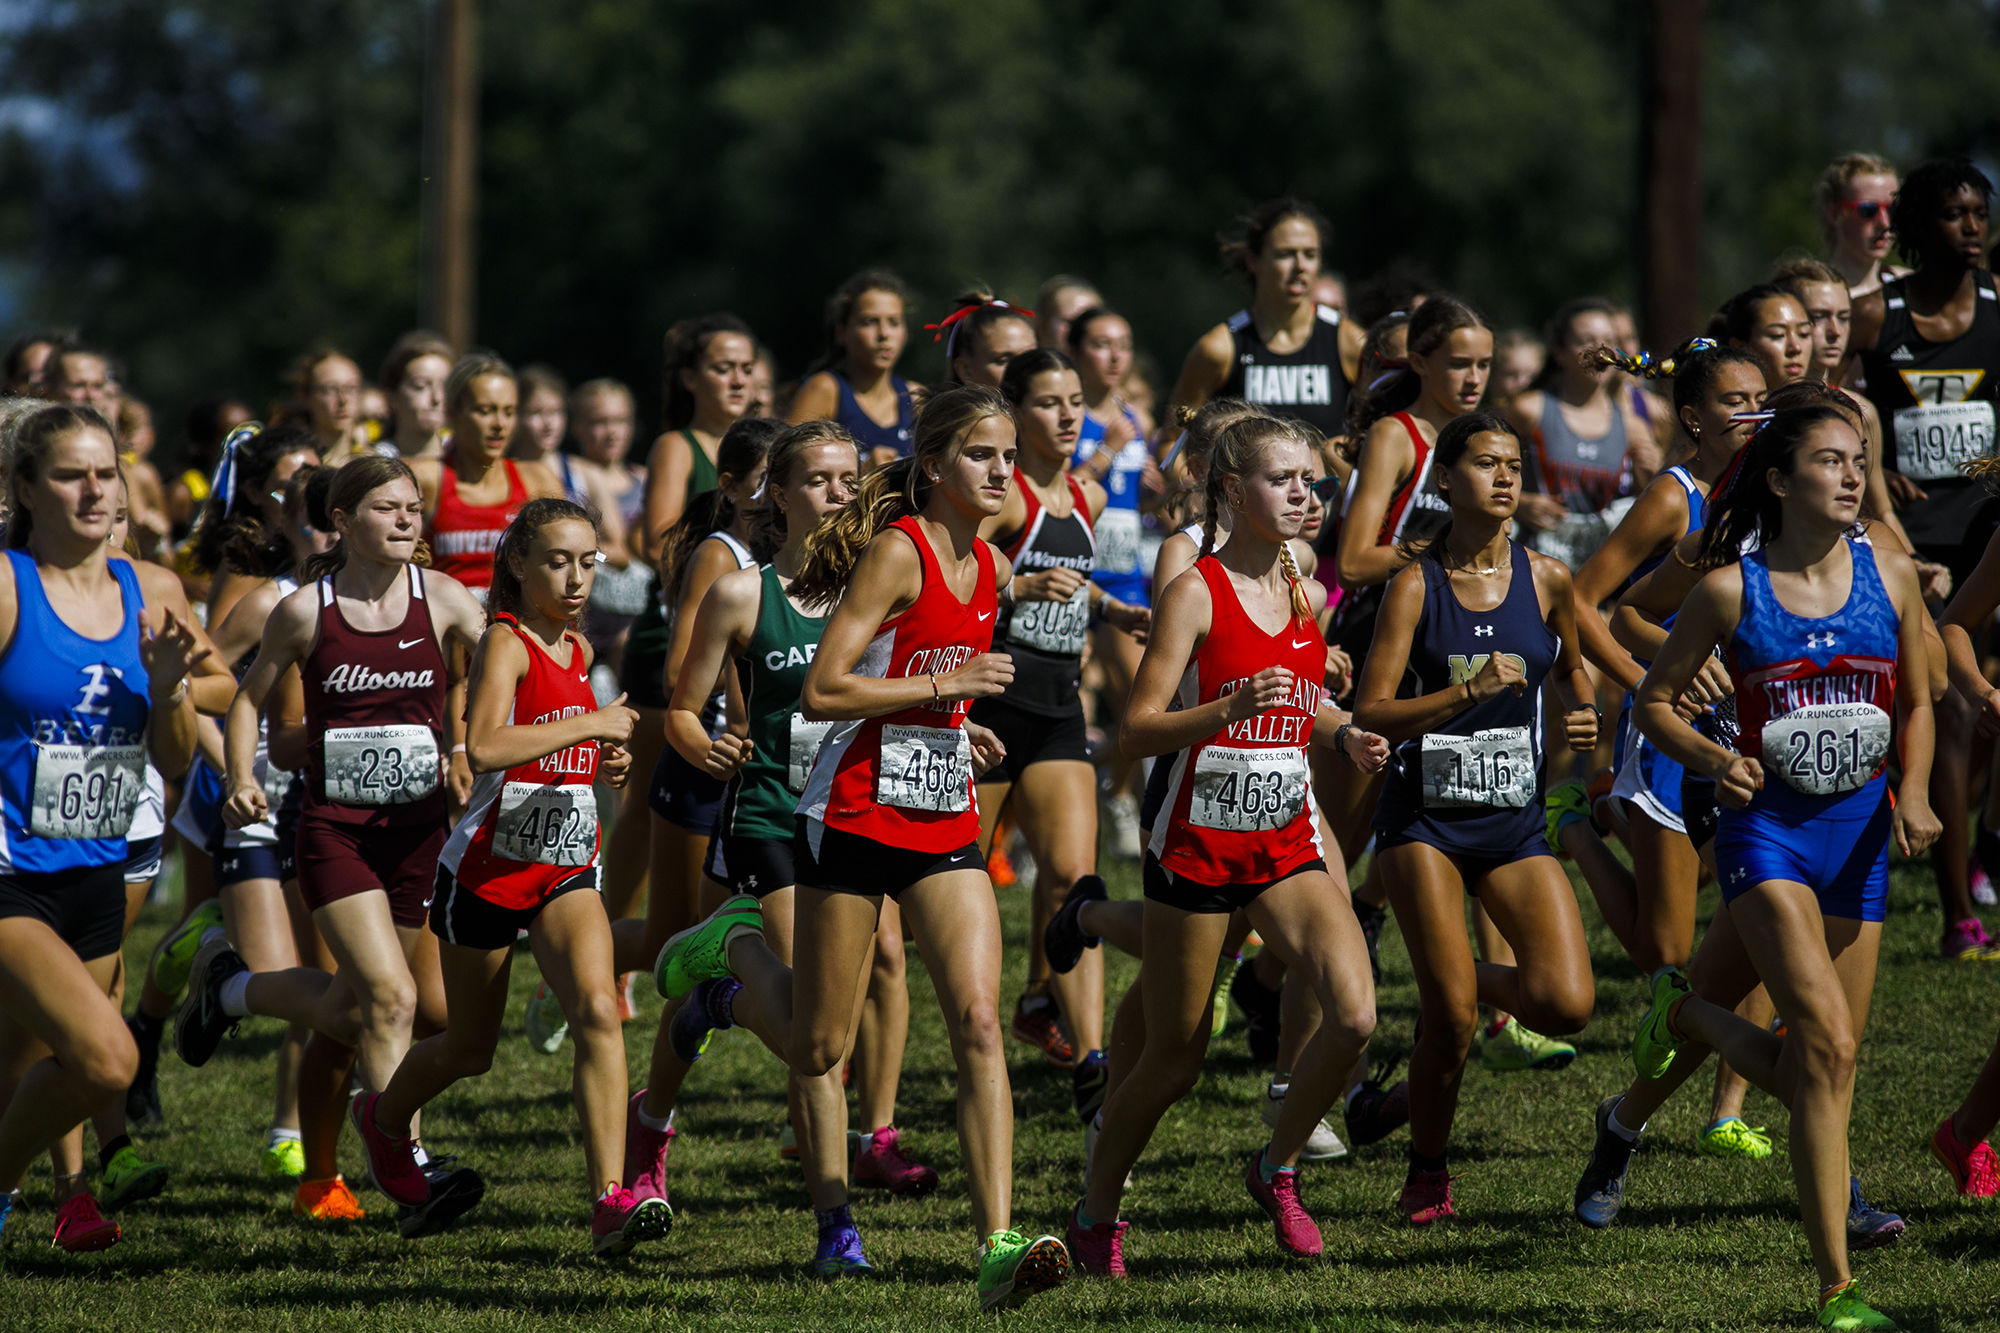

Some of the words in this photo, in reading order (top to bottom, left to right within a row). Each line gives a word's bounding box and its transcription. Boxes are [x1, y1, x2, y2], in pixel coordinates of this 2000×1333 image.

[1245, 364, 1331, 405] HAVEN
[1919, 376, 1965, 405] T
[1908, 422, 1986, 463] 1945
[72, 663, 124, 716] E
[321, 664, 434, 693] Altoona
[1228, 714, 1308, 743] VALLEY
[1783, 707, 1878, 719] WW.RUNCCRS.COM
[334, 729, 425, 739] WWW.RUNCCRS.COM
[1789, 727, 1860, 777] 261
[49, 750, 143, 761] WWW.RUNCCRS.COM
[360, 747, 404, 789] 23
[902, 748, 958, 794] 468
[1207, 750, 1294, 762] WWW.RUNCCRS.COM
[1449, 750, 1512, 793] 116
[59, 772, 124, 821] 691
[1215, 771, 1284, 815] 463
[517, 806, 580, 849] 462
